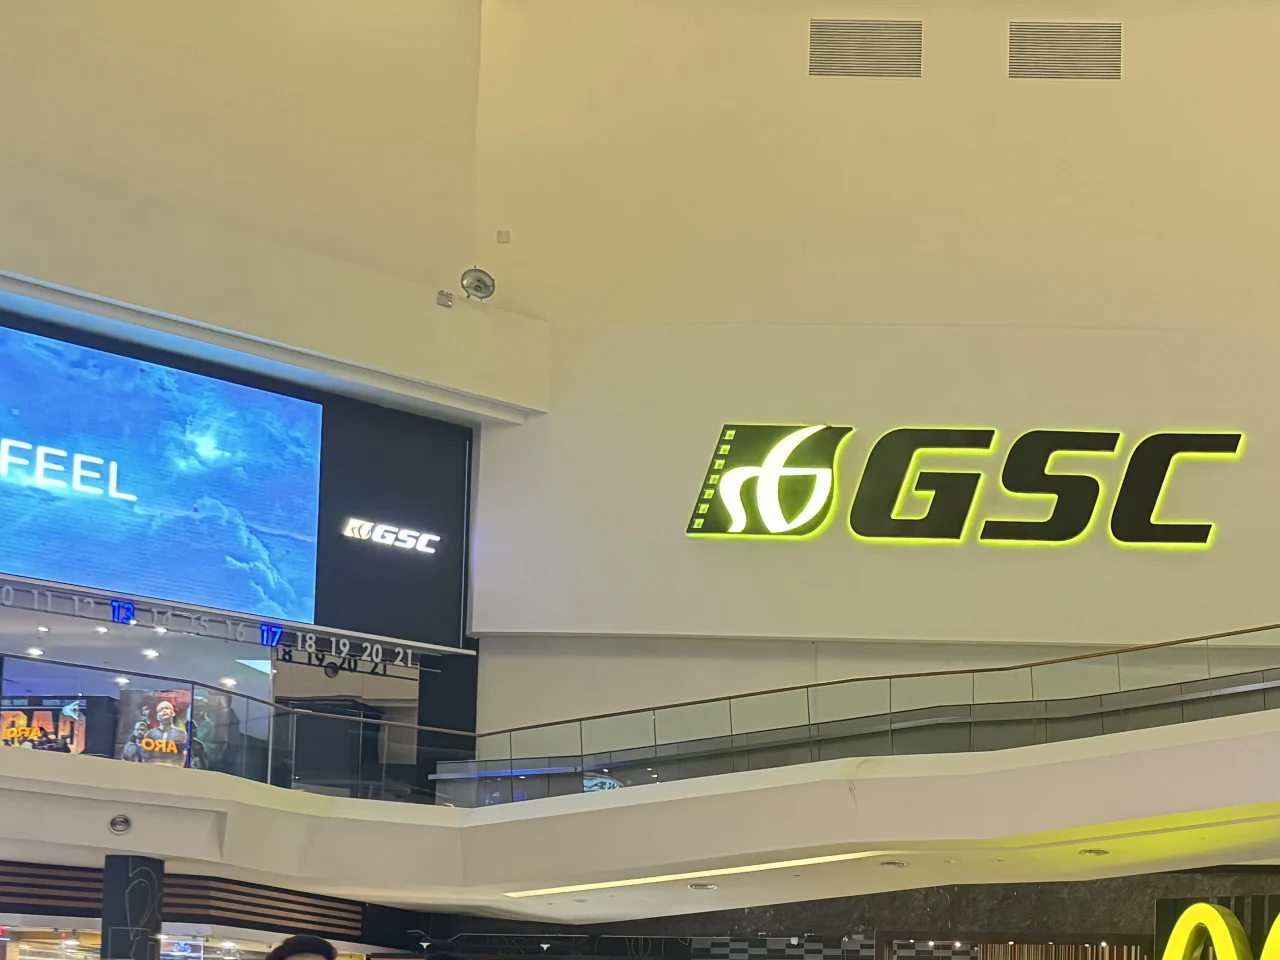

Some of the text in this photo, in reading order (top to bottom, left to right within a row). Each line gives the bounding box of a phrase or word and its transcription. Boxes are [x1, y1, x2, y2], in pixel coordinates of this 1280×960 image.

[0, 438, 138, 502] FEEL
[849, 426, 1245, 546] GSC
[371, 524, 441, 554] GSC
[110, 599, 136, 625] 13
[225, 619, 245, 642] 16
[260, 624, 283, 648] 17
[295, 631, 316, 653] 18
[329, 636, 350, 658] 19
[362, 642, 383, 663] 20
[394, 648, 413, 668] 21
